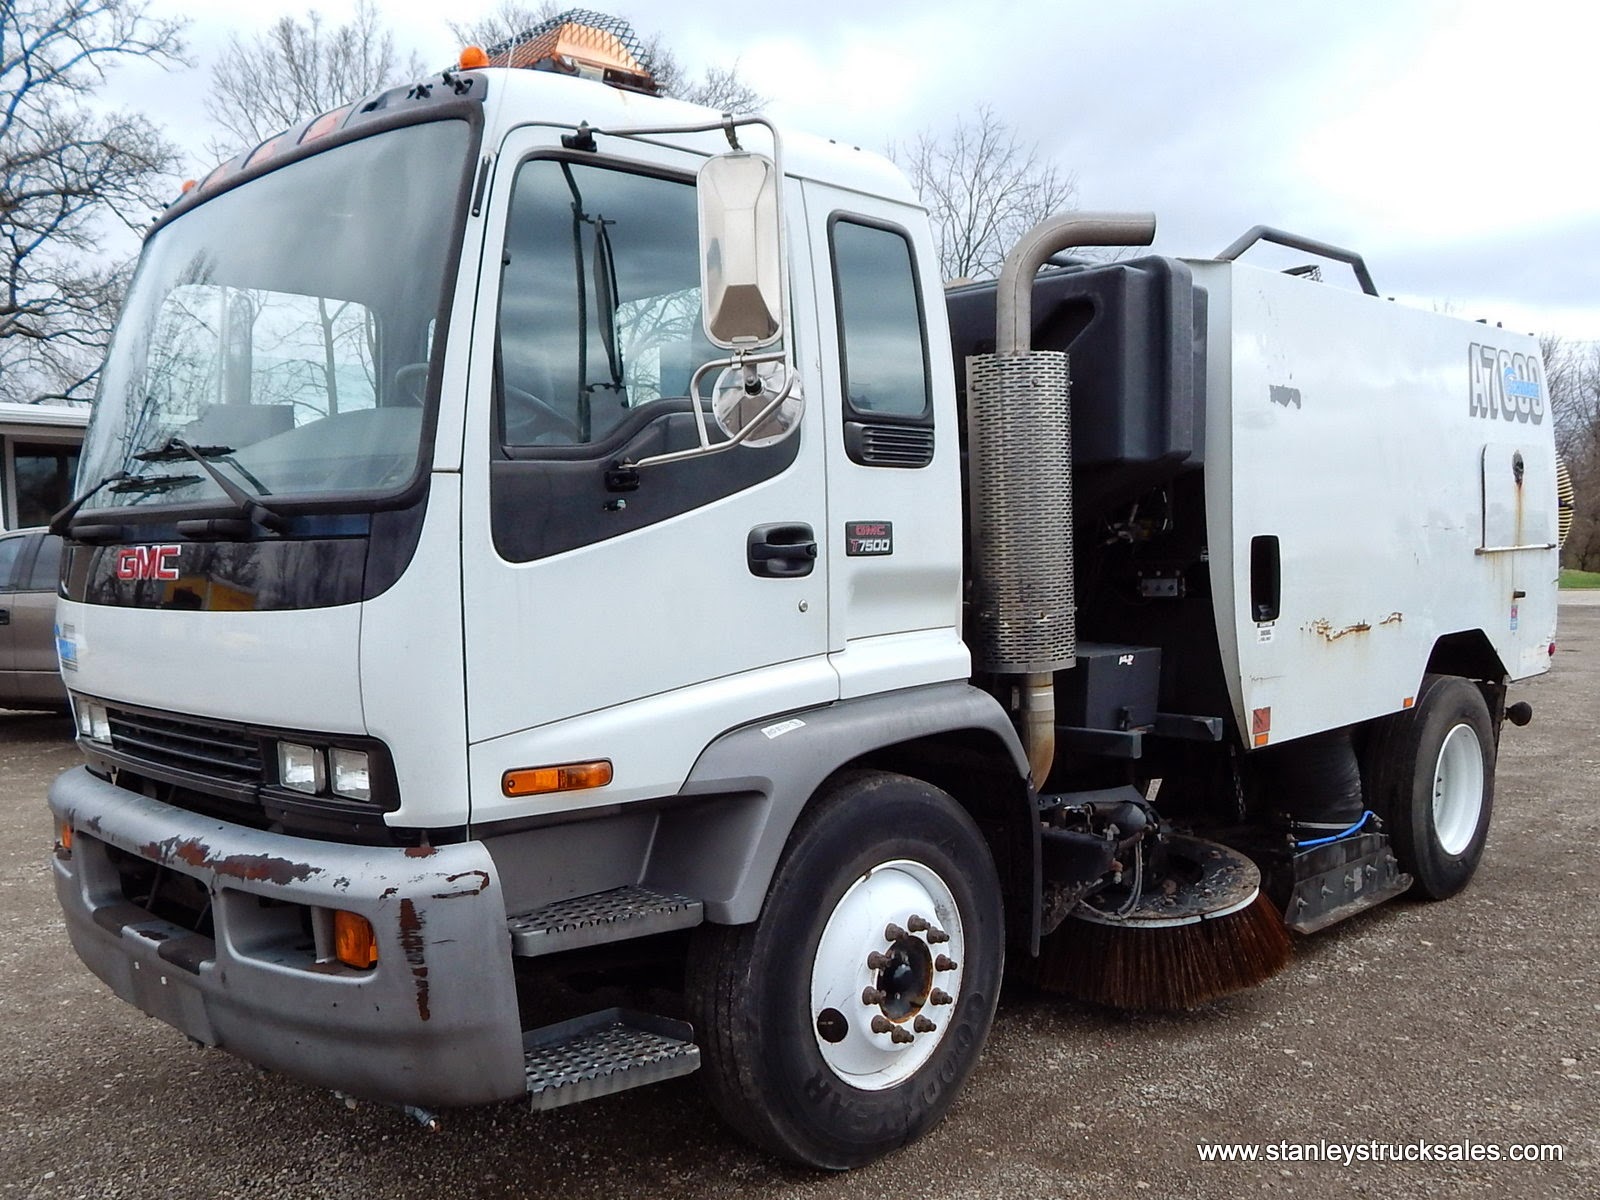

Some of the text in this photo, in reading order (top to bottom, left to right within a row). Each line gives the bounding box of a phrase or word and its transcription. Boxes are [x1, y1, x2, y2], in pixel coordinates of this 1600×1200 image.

[856, 524, 886, 536] GMC
[850, 539, 890, 552] T7500
[117, 545, 181, 580] GMC
